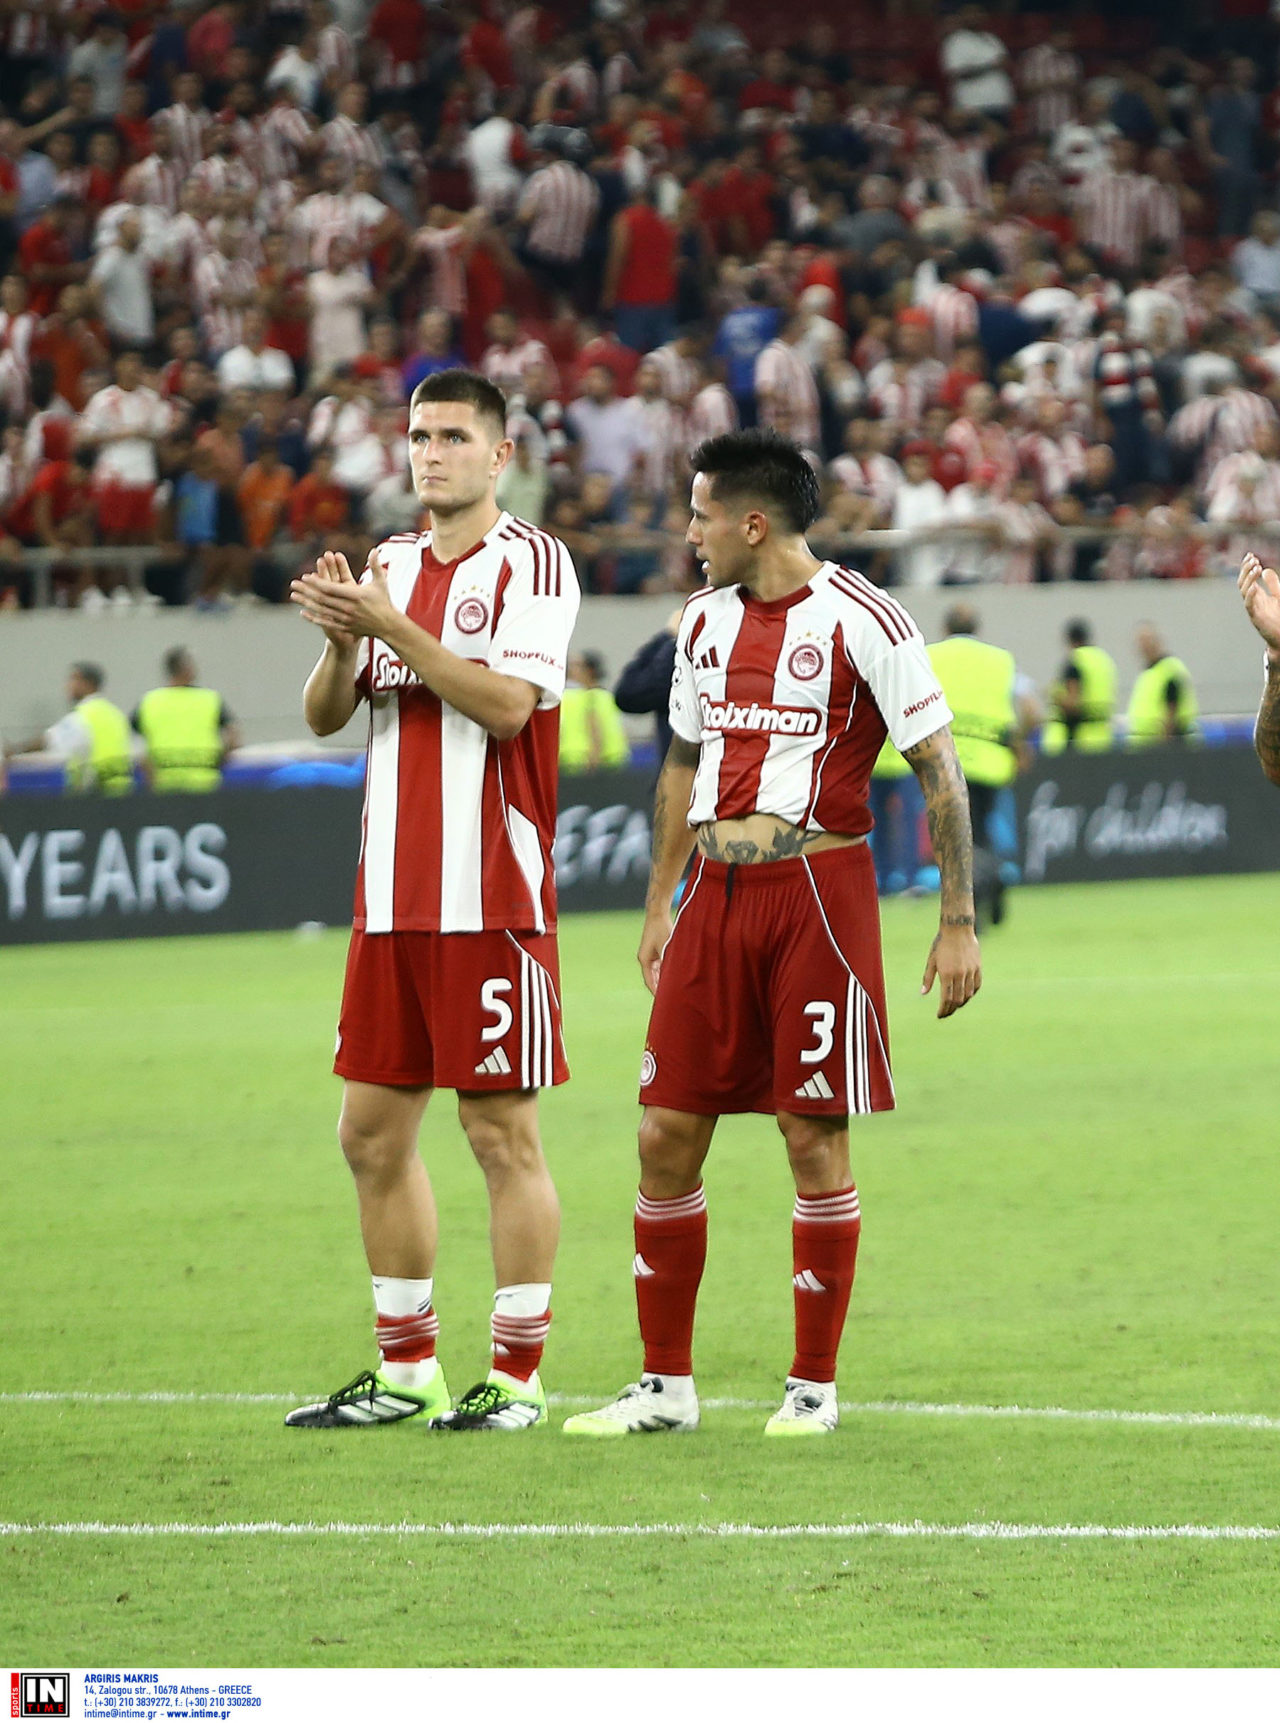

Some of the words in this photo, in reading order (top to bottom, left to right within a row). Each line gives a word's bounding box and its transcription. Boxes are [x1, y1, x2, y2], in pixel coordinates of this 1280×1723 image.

[0, 822, 231, 920] YEARS
[556, 803, 652, 888] EFA
[480, 977, 514, 1042] 5
[800, 1001, 836, 1064] 3
